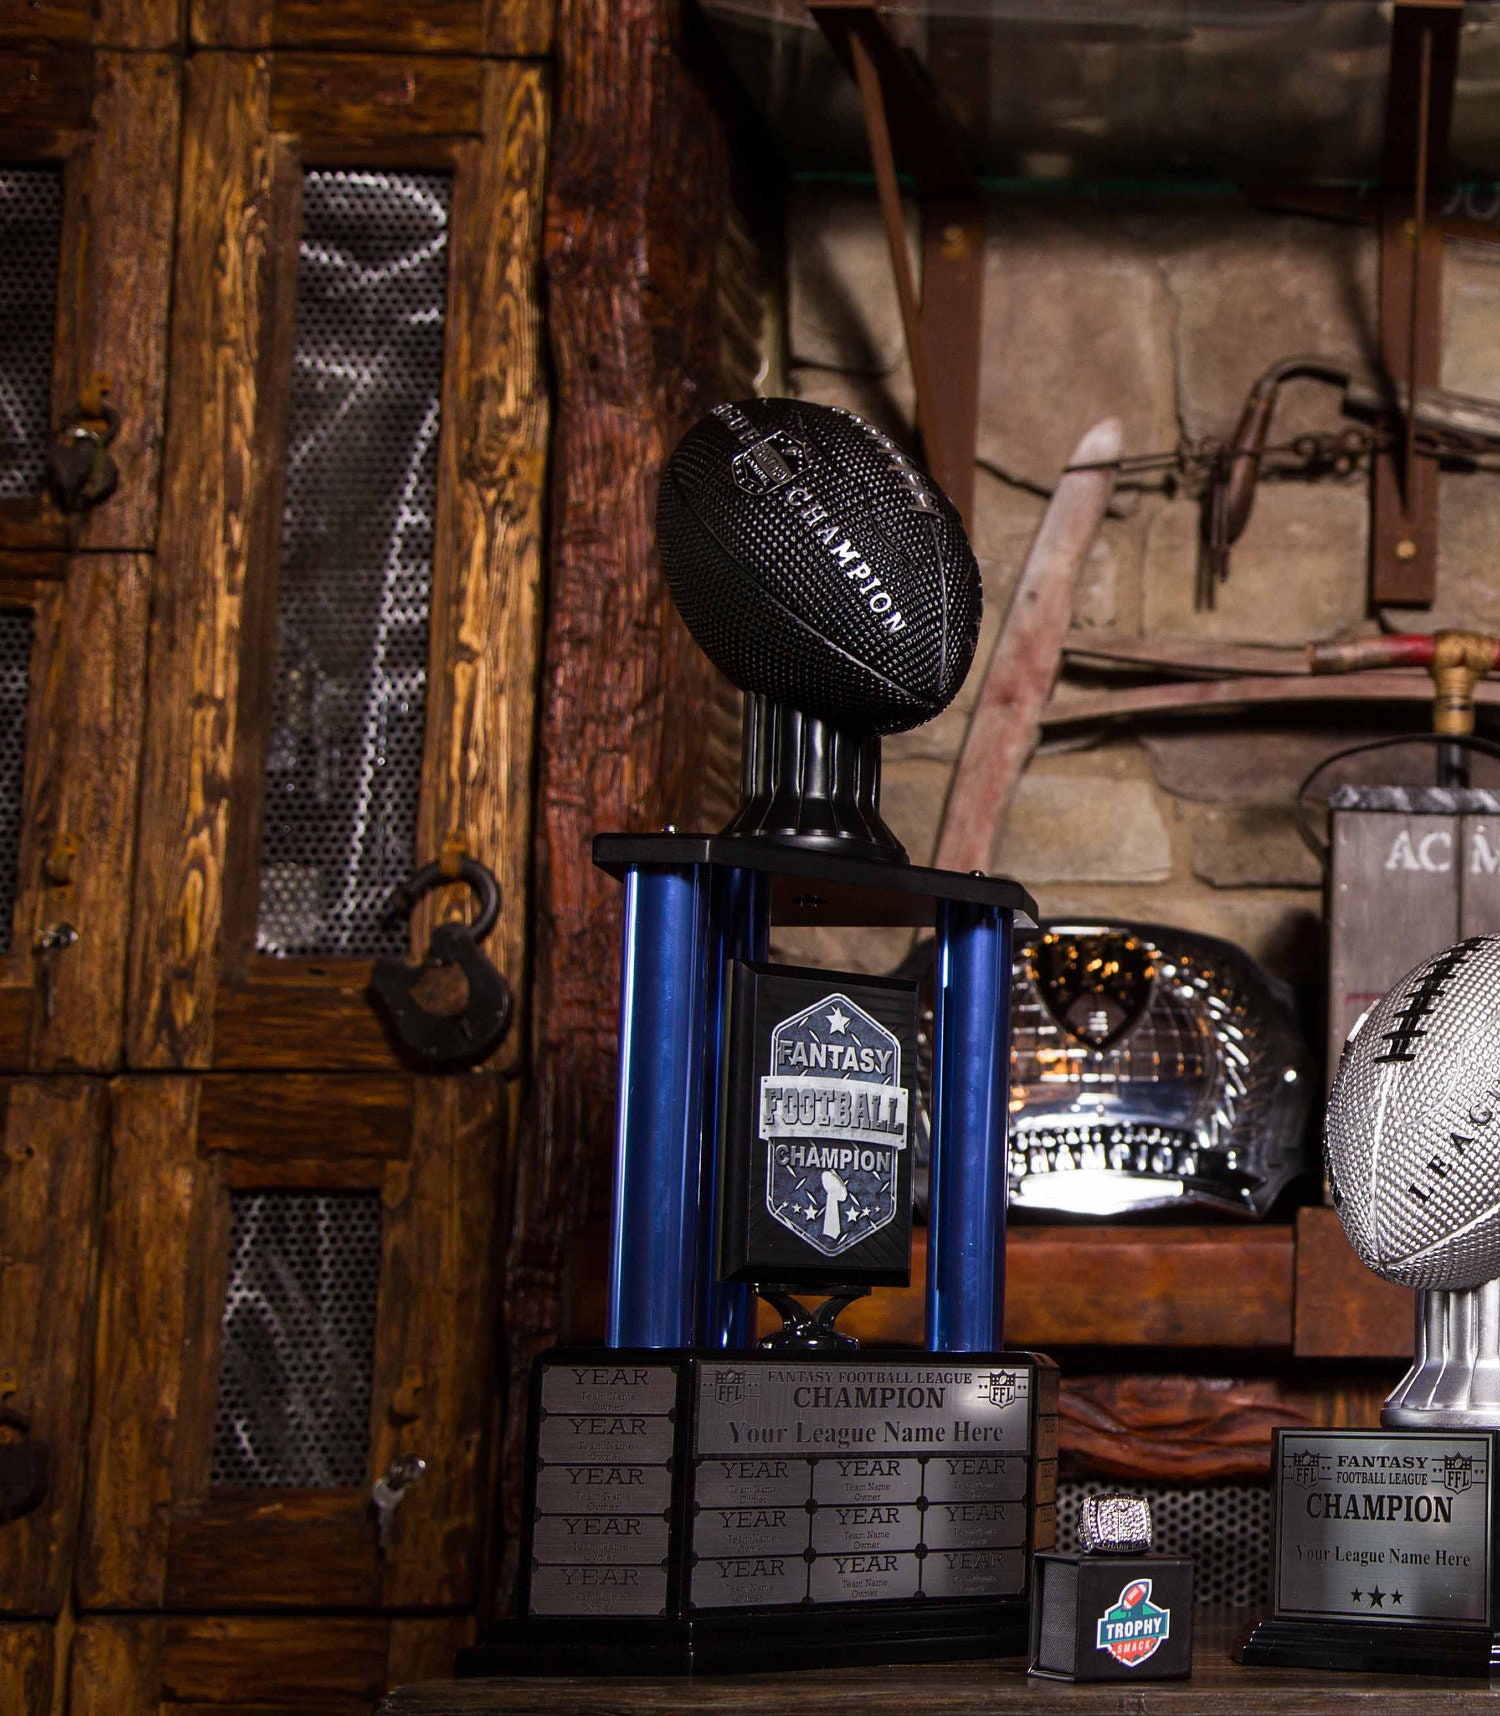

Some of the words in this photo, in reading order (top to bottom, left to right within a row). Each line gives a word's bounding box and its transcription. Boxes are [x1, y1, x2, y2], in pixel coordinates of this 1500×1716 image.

[788, 487, 906, 635] CHAMPION
[778, 1039, 893, 1075] FANTASY
[763, 1087, 904, 1136] FOOTBALL
[775, 1144, 891, 1172] CHAMPION
[571, 1368, 649, 1385] YEAR
[768, 1371, 834, 1383] FANTASY
[839, 1371, 912, 1384] FOOTBALL
[917, 1372, 972, 1384] LEAGUE
[793, 1387, 946, 1409] CHAMPION
[992, 1387, 1014, 1402] FFL
[568, 1418, 647, 1435] YEAR
[728, 1421, 788, 1444] Your
[795, 1421, 876, 1449] League
[883, 1421, 945, 1442] Name
[953, 1421, 1004, 1442] Here
[720, 1462, 788, 1478] YEAR
[837, 1460, 900, 1477] YEAR
[946, 1459, 1006, 1475] YEAR
[1337, 1455, 1429, 1469] FANTASY
[565, 1468, 645, 1485] YEAR
[1336, 1471, 1386, 1484] FOOTBALL
[1388, 1472, 1428, 1486] LEAGUE
[1448, 1471, 1470, 1488] FFL
[835, 1507, 900, 1525] YEAR
[945, 1505, 1006, 1522] YEAR
[1306, 1493, 1453, 1523] CHAMPION
[562, 1518, 641, 1535] YEAR
[718, 1511, 787, 1528] YEAR
[833, 1555, 898, 1574] YEAR
[1335, 1546, 1385, 1567] League
[1389, 1548, 1431, 1565] Name
[1435, 1550, 1470, 1567] Here
[560, 1568, 639, 1585] YEAR
[716, 1559, 785, 1578] YEAR
[1106, 1616, 1162, 1640] TROPHY
[1117, 1639, 1151, 1654] SMACK
